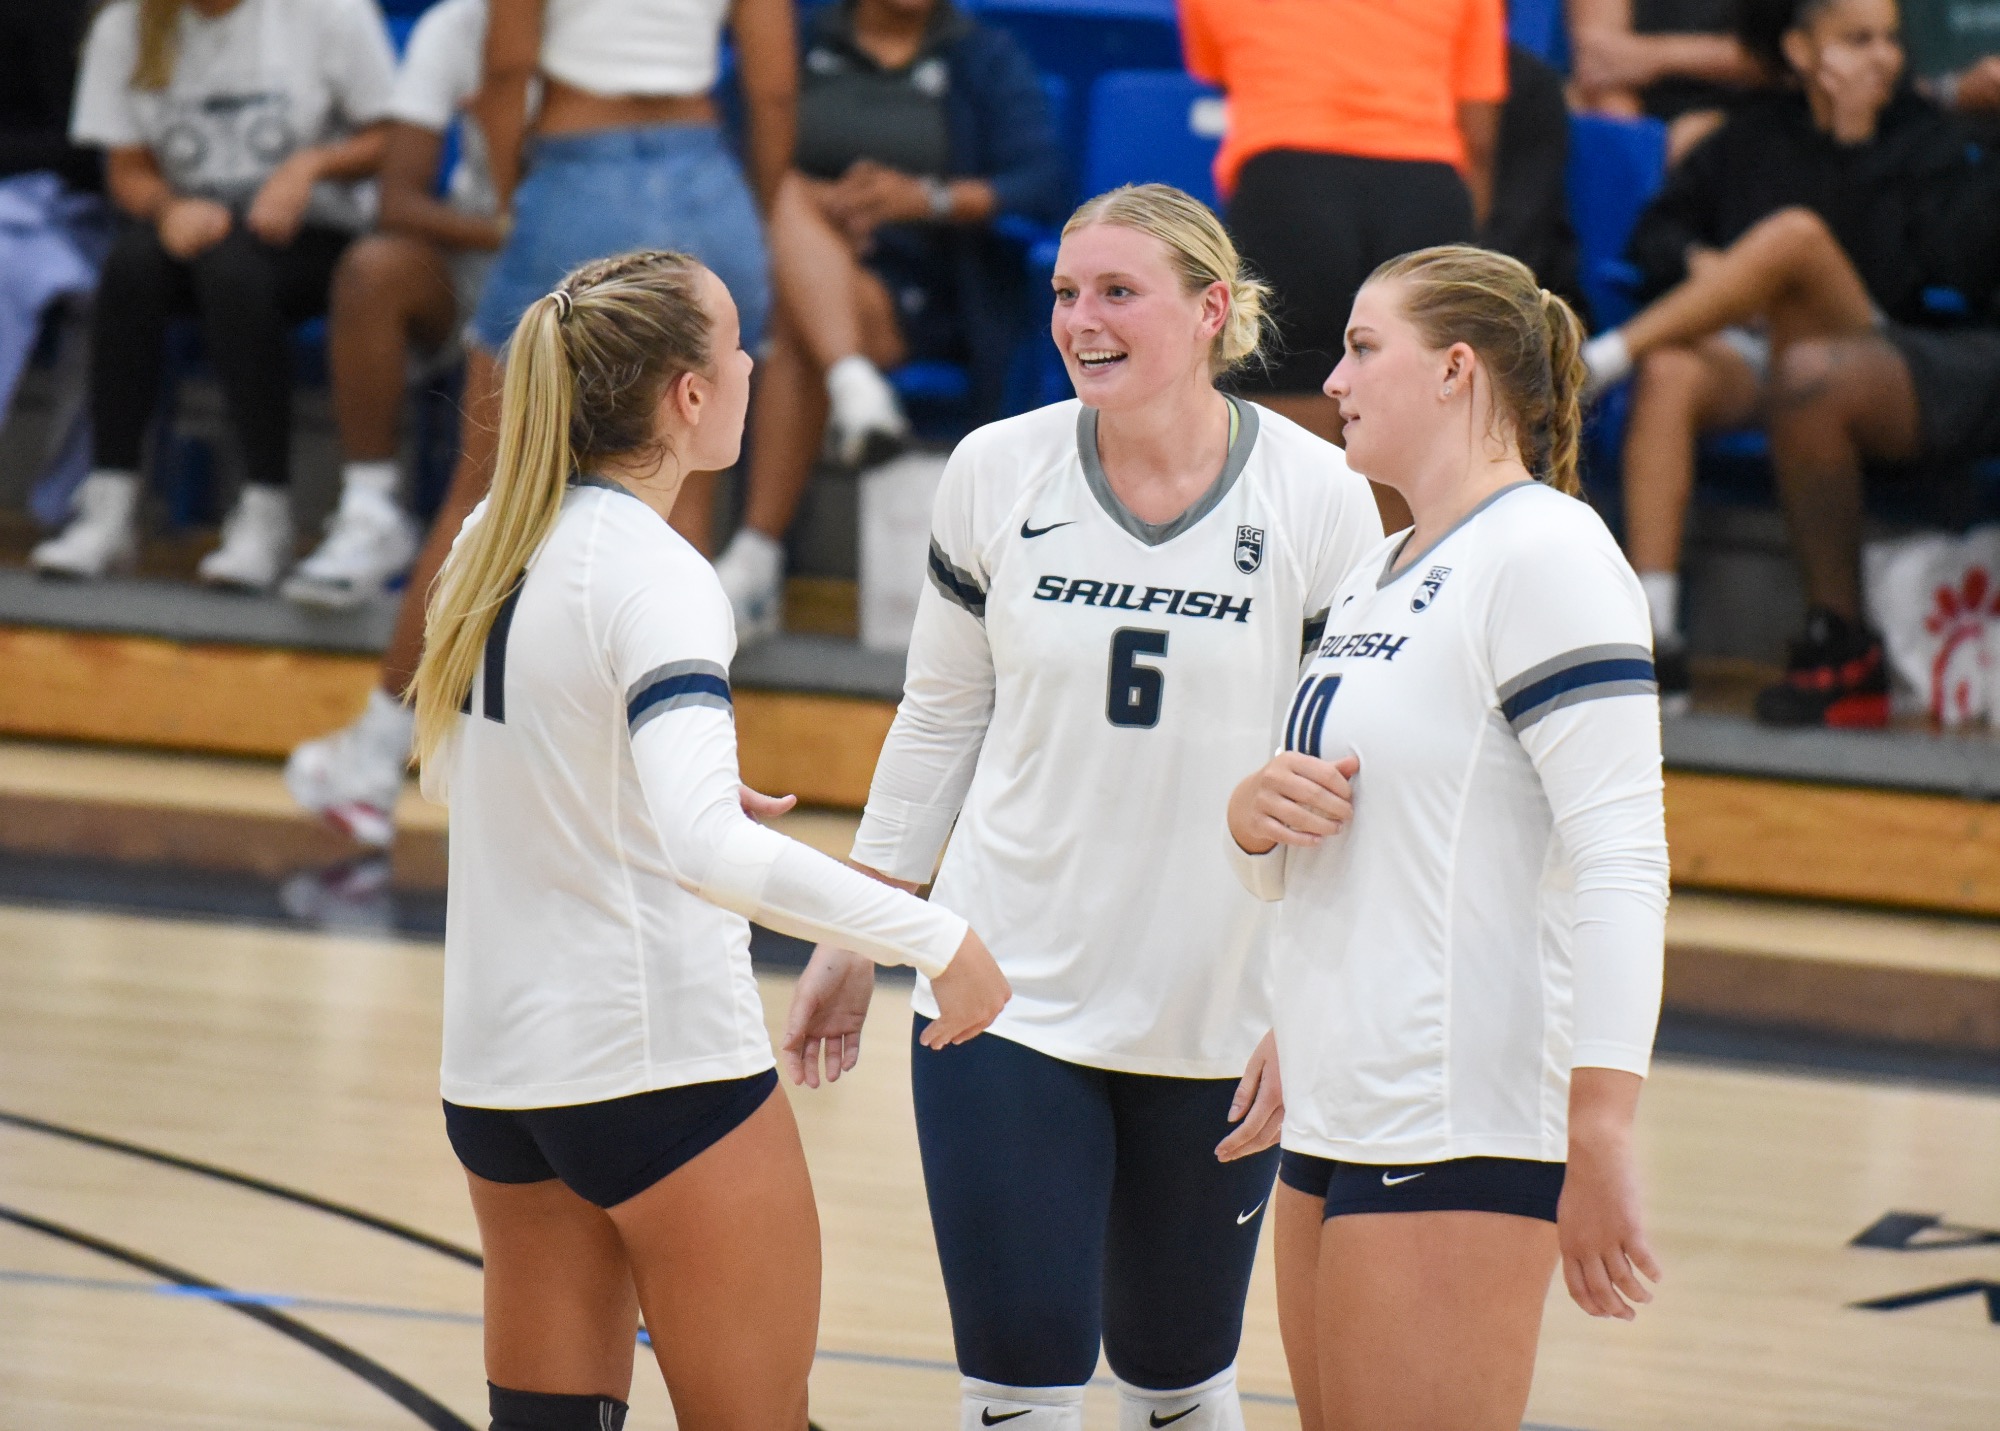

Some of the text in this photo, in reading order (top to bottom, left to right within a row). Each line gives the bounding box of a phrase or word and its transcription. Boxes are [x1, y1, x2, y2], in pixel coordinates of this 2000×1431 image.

[1239, 528, 1261, 543] SSC
[1033, 575, 1254, 623] SAILFISH
[1318, 632, 1409, 660] AILFISH
[1105, 625, 1170, 729] 6
[1285, 672, 1343, 759] 10
